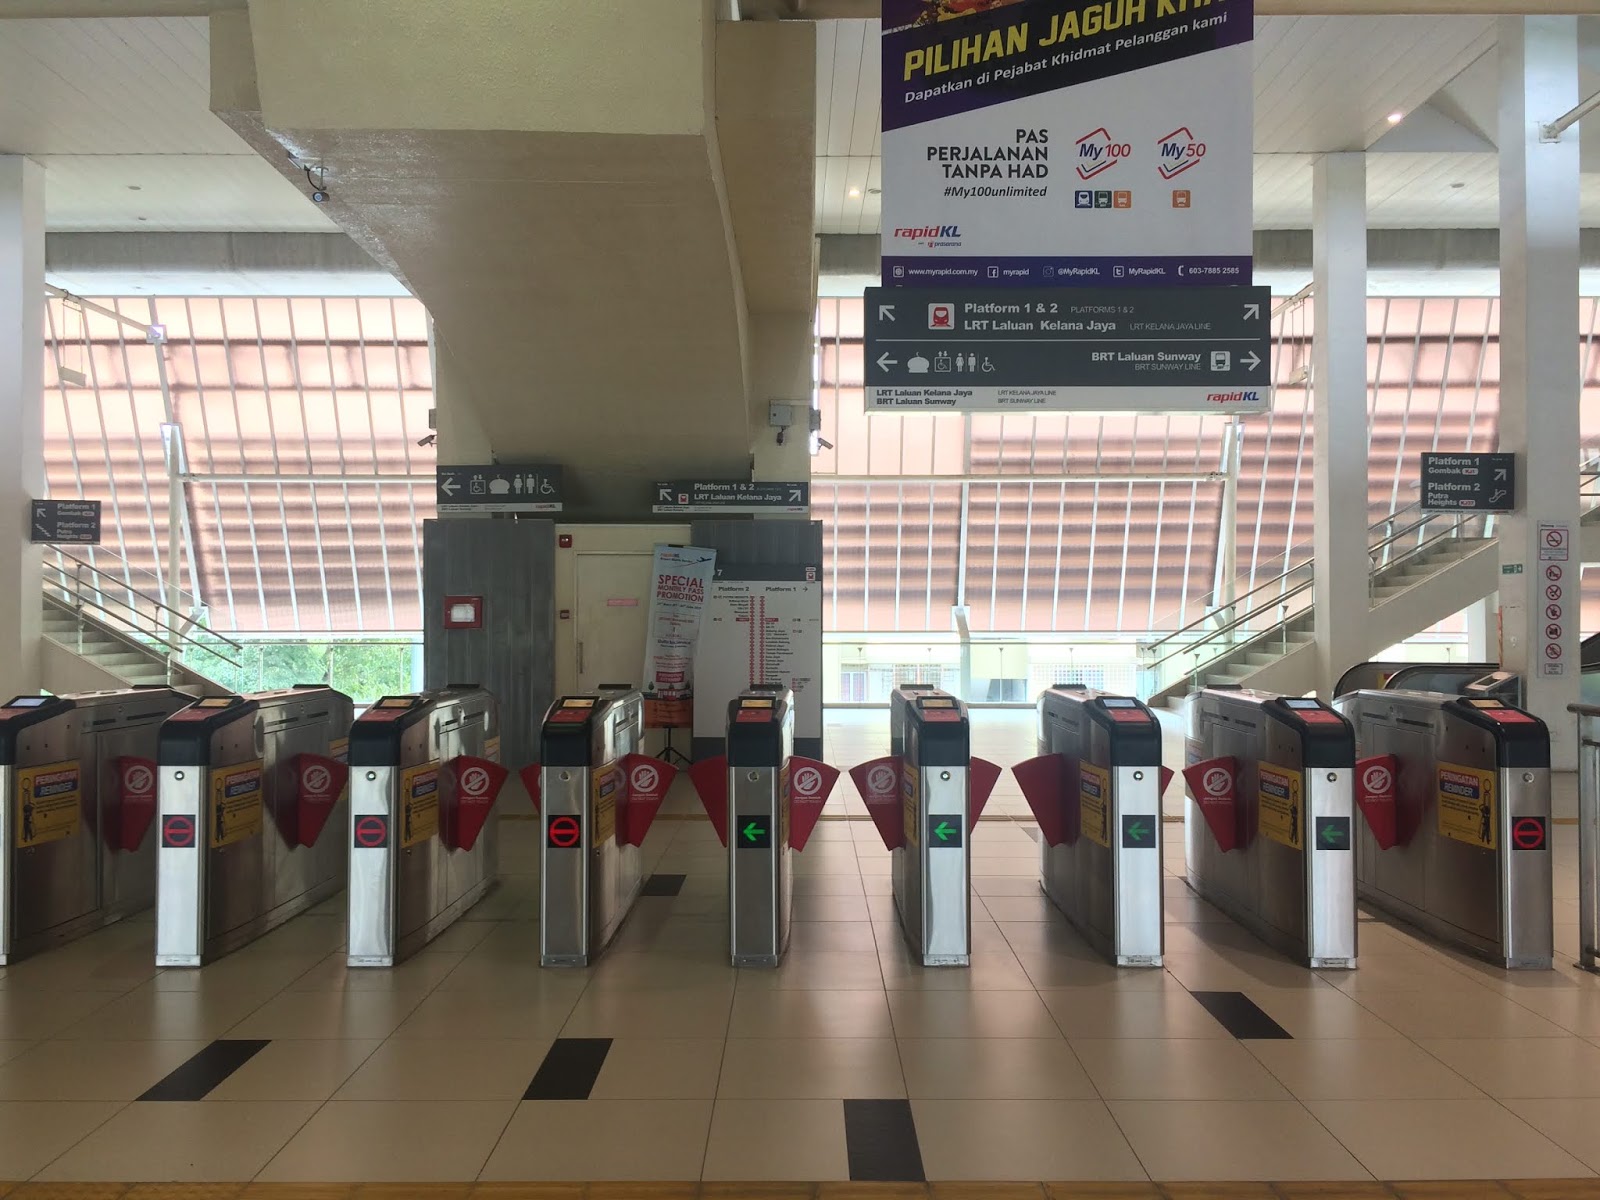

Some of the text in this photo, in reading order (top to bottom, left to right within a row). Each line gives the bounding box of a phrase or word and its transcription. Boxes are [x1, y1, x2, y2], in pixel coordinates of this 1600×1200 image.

[904, 0, 1146, 81] PILIHAN JAGUH
[905, 12, 1228, 103] Dapatkan di Pejabat Khidmat Pelanggan kami
[1016, 128, 1049, 143] PAS
[927, 146, 1048, 161] PERJALANAN
[1079, 143, 1131, 161] My100
[1161, 143, 1206, 160] My50
[942, 164, 1049, 178] TANPA HAD
[944, 186, 1048, 199] #My100unlimited
[894, 226, 962, 240] rapidKL
[908, 267, 978, 276] www.myrapid.com.my
[1003, 267, 1030, 276] myrapid
[1057, 267, 1100, 276] @MyRapidKL
[1128, 267, 1166, 276] MyRapidKL
[1188, 266, 1240, 275] 603-7885 2585
[964, 303, 1059, 313] Platform 1 & 2
[964, 320, 1116, 333] LRT Laluan Kelana Jaya
[1130, 323, 1212, 331] LRT KELANA JAYA LINE
[1091, 352, 1201, 363] BRT Laluan Sunway
[1134, 363, 1201, 371] BRT SUNWAY LINE
[953, 389, 973, 398] Jaya
[1207, 391, 1260, 403] rapidKL
[924, 398, 957, 406] Sunway
[1428, 457, 1480, 466] Platform 1
[1428, 483, 1481, 491] Platform 2
[1428, 499, 1457, 507] Heights
[658, 574, 704, 588] SPECIAL
[656, 591, 704, 602] PROMOTION
[1440, 771, 1478, 786] PERINGATAN
[1444, 782, 1473, 797] REMINDER
